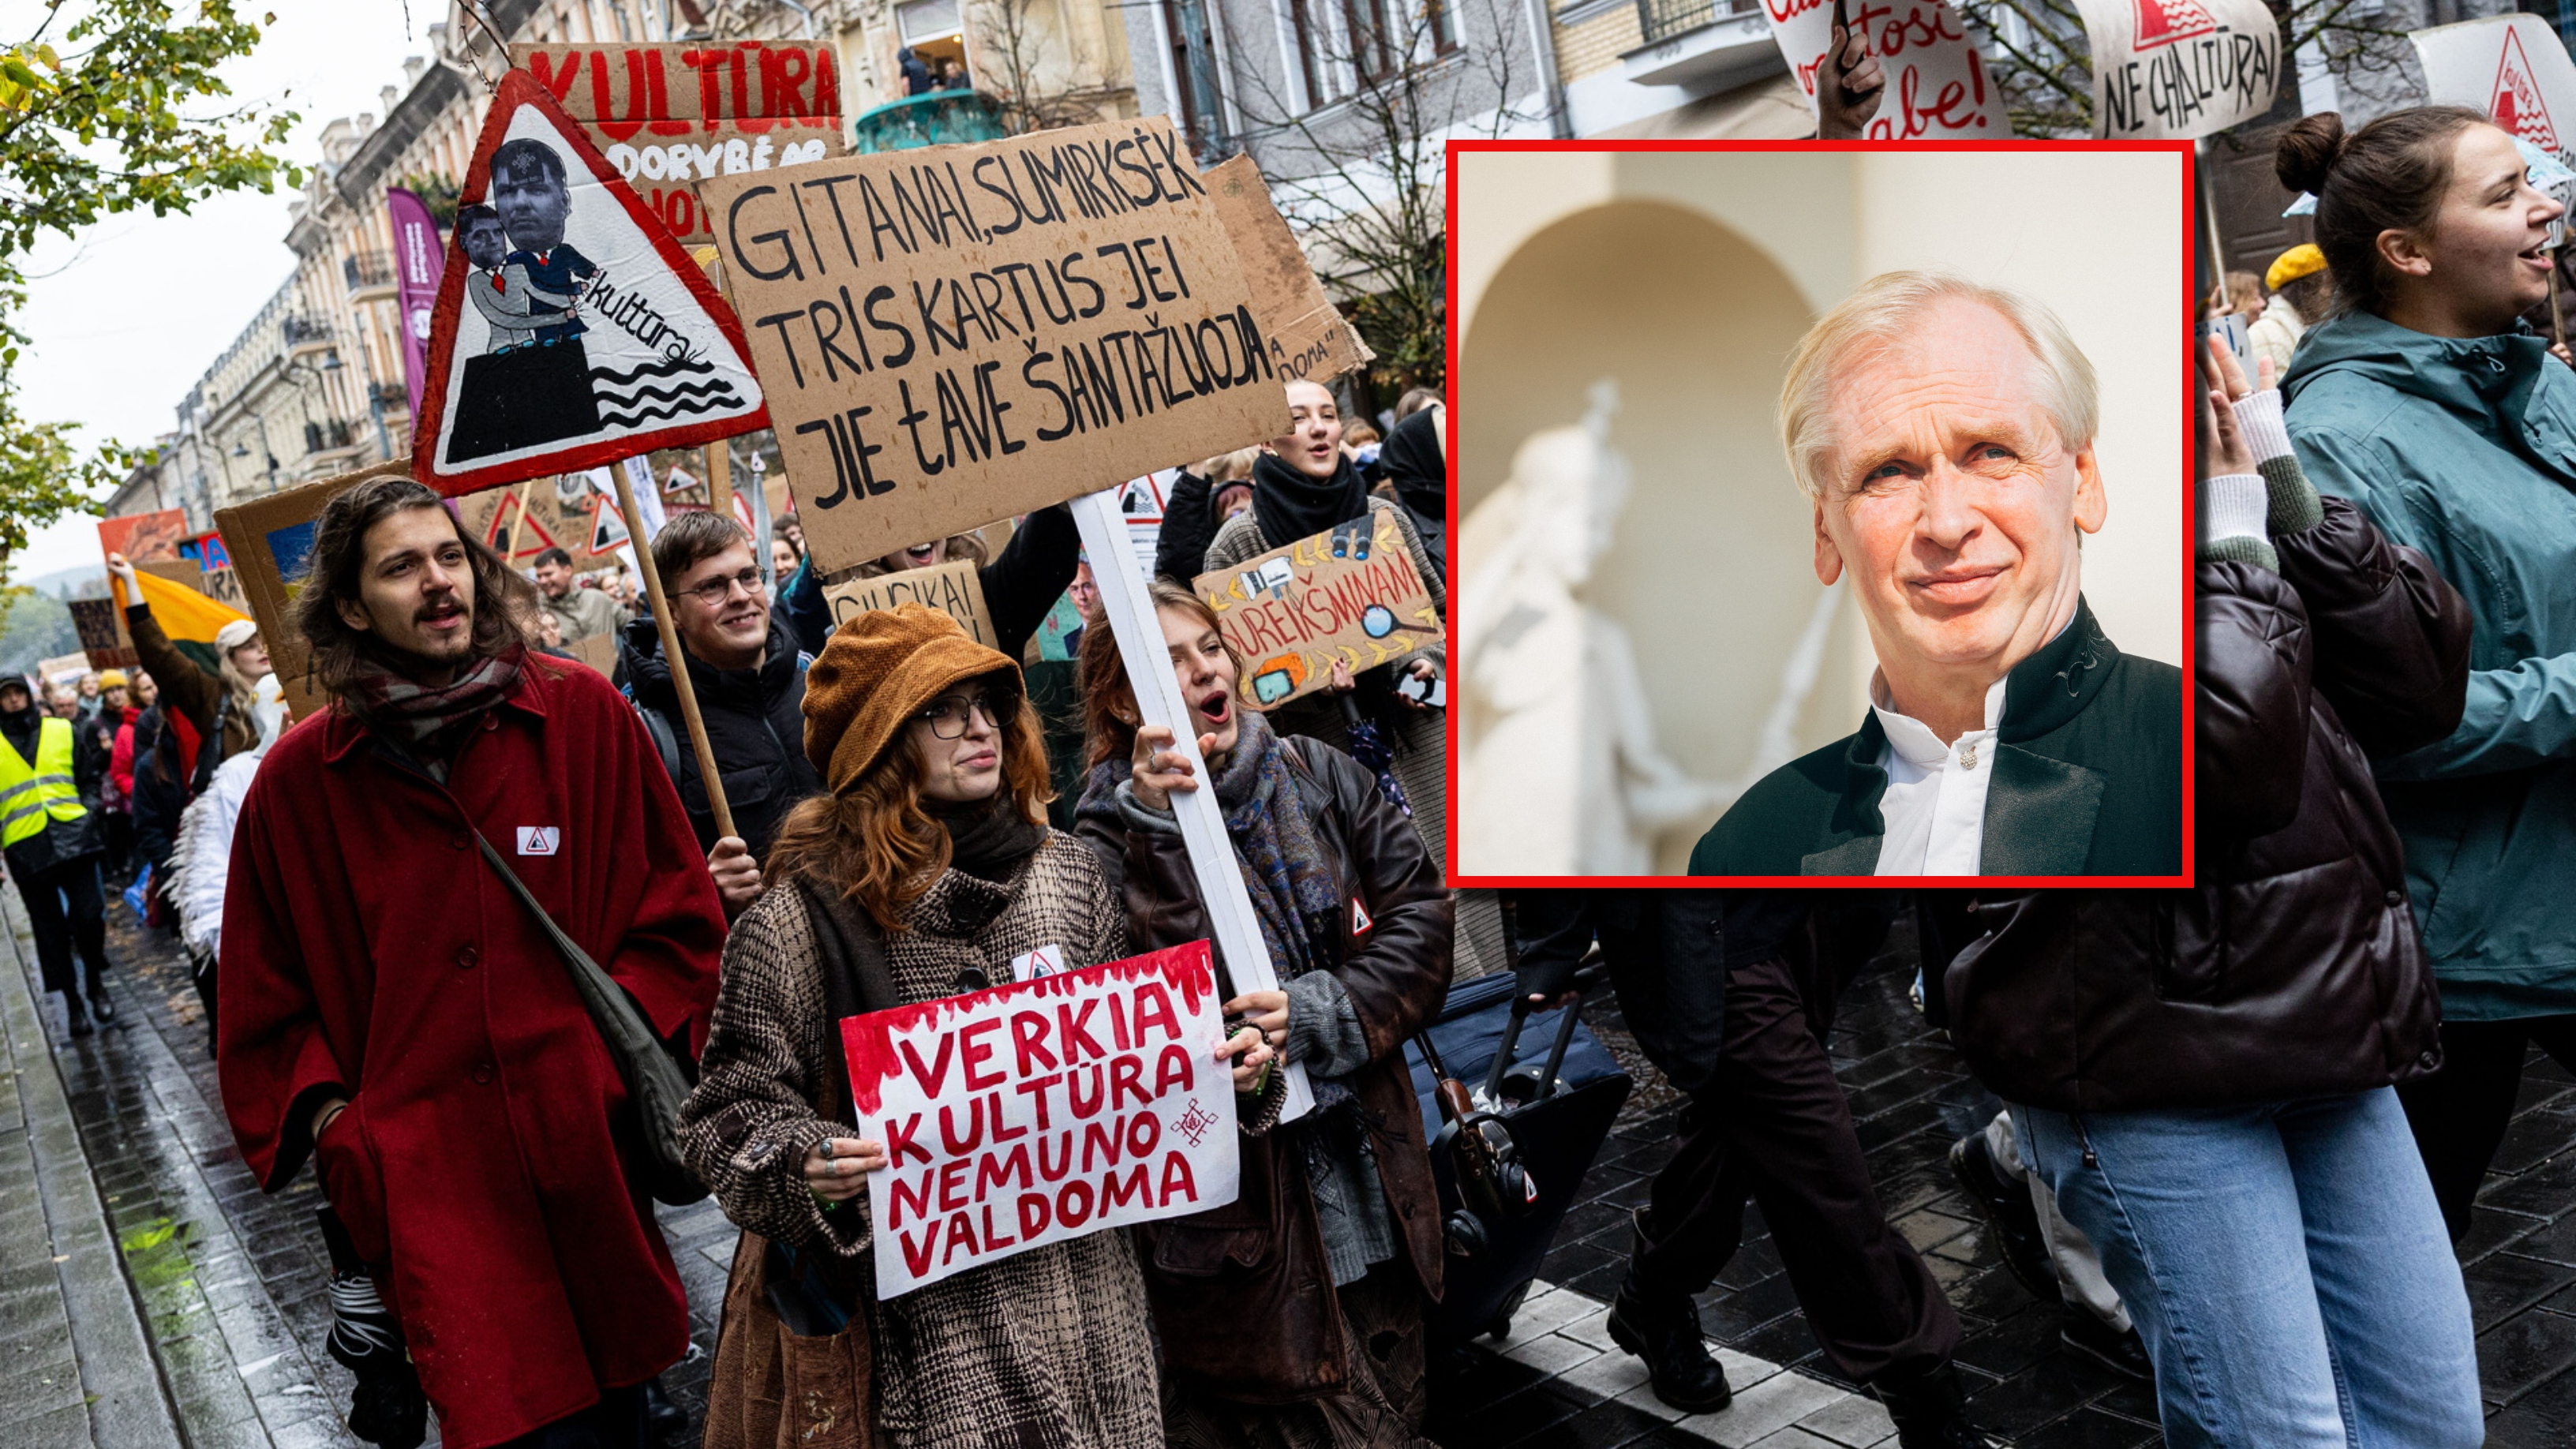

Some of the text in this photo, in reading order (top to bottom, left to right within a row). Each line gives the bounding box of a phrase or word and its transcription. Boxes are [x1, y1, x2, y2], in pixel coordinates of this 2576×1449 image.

[529, 40, 840, 141] KULTŪRA
[2105, 62, 2144, 139] NE
[584, 270, 691, 361] kultūra
[755, 234, 1190, 390] TRIS KARTUS JEI
[796, 406, 897, 511] JIE
[1021, 303, 1274, 442] ŠANTAŽUOJA
[899, 981, 1183, 1101] VERKIA
[885, 1043, 1195, 1170] KULTŪRA
[889, 1110, 1162, 1232] NEMUNO
[899, 1150, 1199, 1279] VALDOMA
